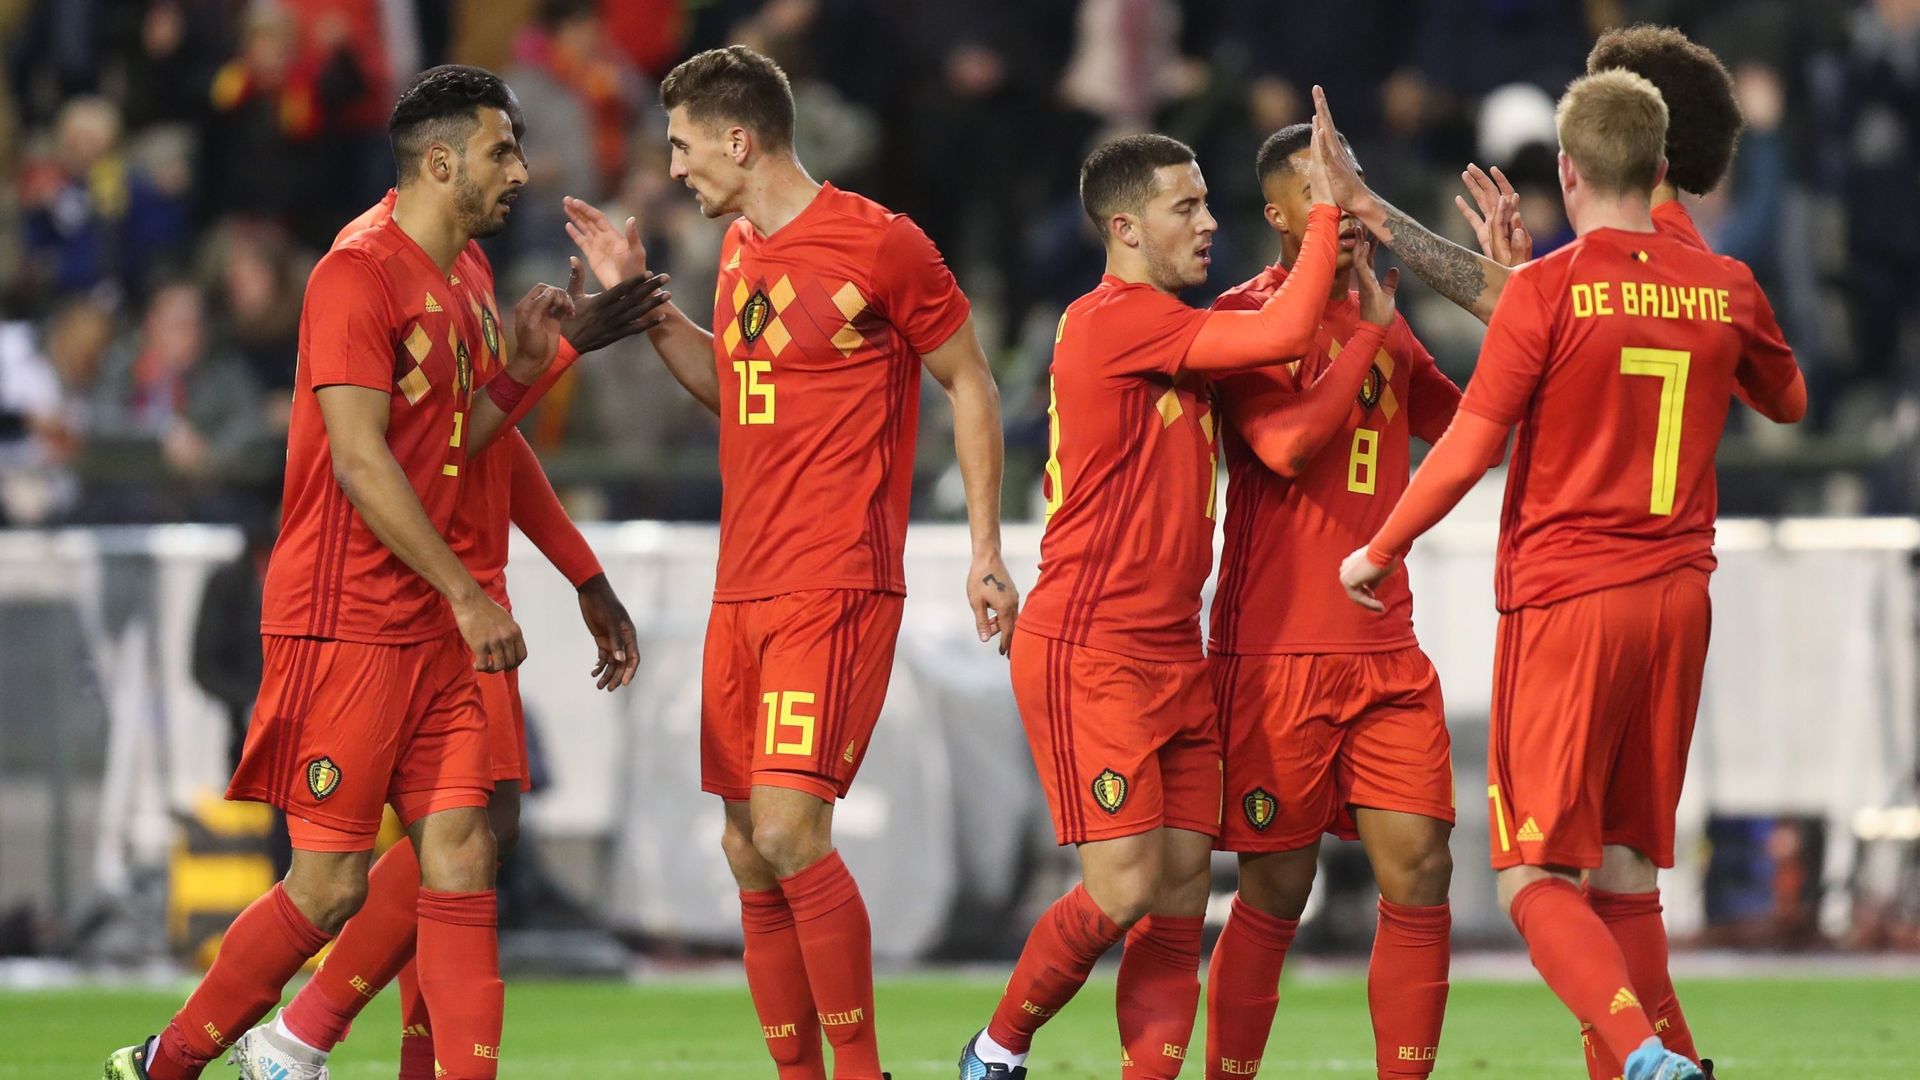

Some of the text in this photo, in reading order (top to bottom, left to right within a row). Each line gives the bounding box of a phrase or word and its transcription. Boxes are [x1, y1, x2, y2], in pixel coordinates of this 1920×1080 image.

[1571, 282, 1732, 323] DE BRUYNE
[733, 360, 775, 425] 15
[1347, 427, 1379, 496] 8
[1620, 347, 1691, 516] 7
[762, 690, 815, 756] 15
